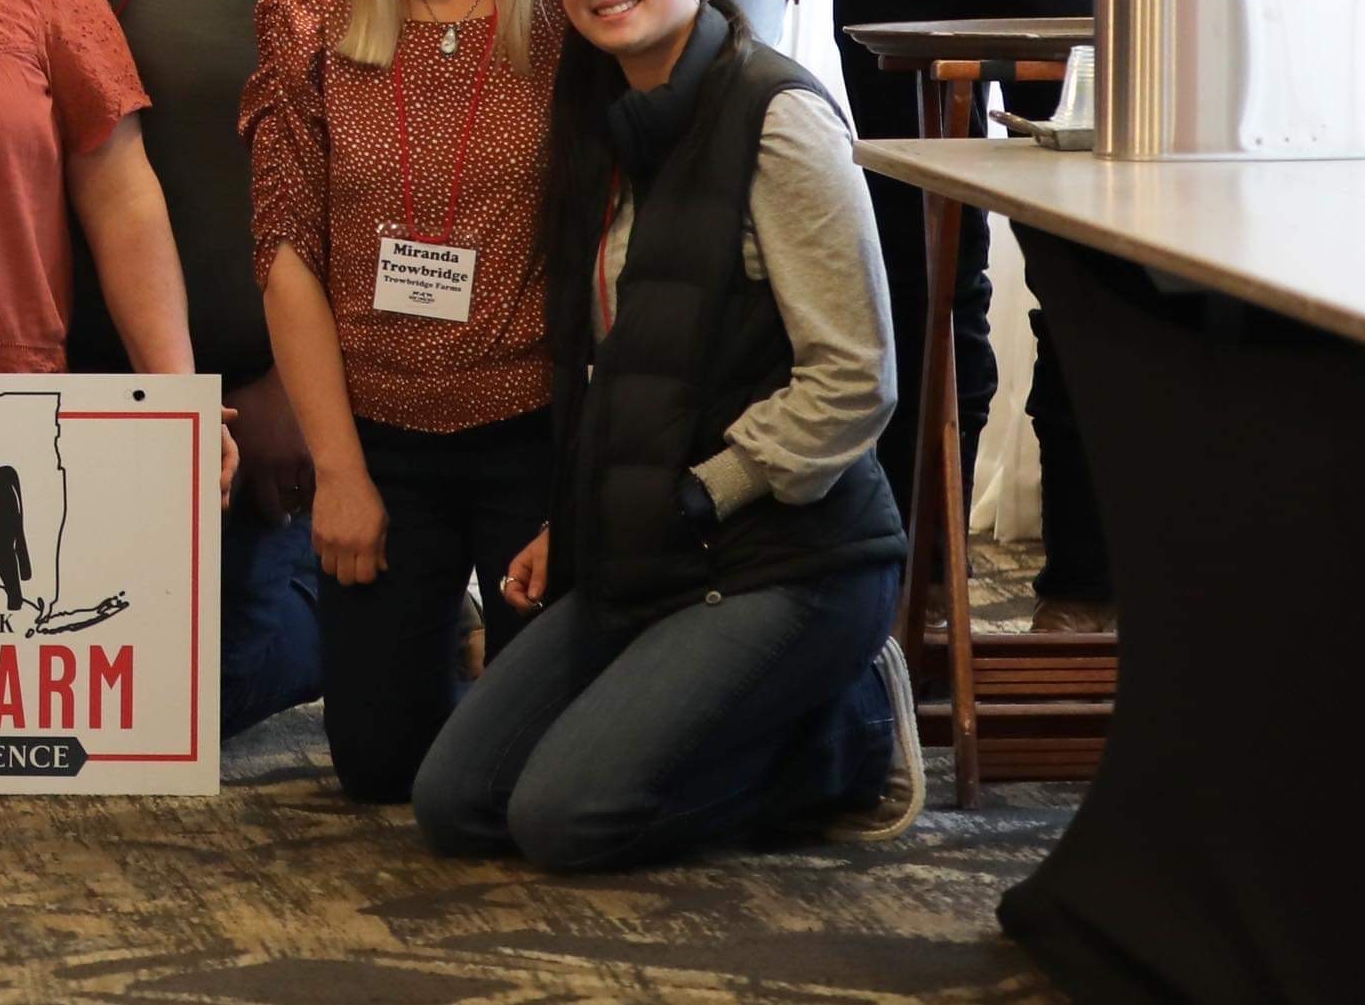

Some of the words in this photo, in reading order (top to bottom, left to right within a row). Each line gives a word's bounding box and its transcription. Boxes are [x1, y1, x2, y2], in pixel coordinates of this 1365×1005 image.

[393, 243, 460, 264] Miranda
[381, 259, 469, 284] Trowbridge
[383, 275, 434, 290] Trowbridge
[435, 282, 462, 293] Farms
